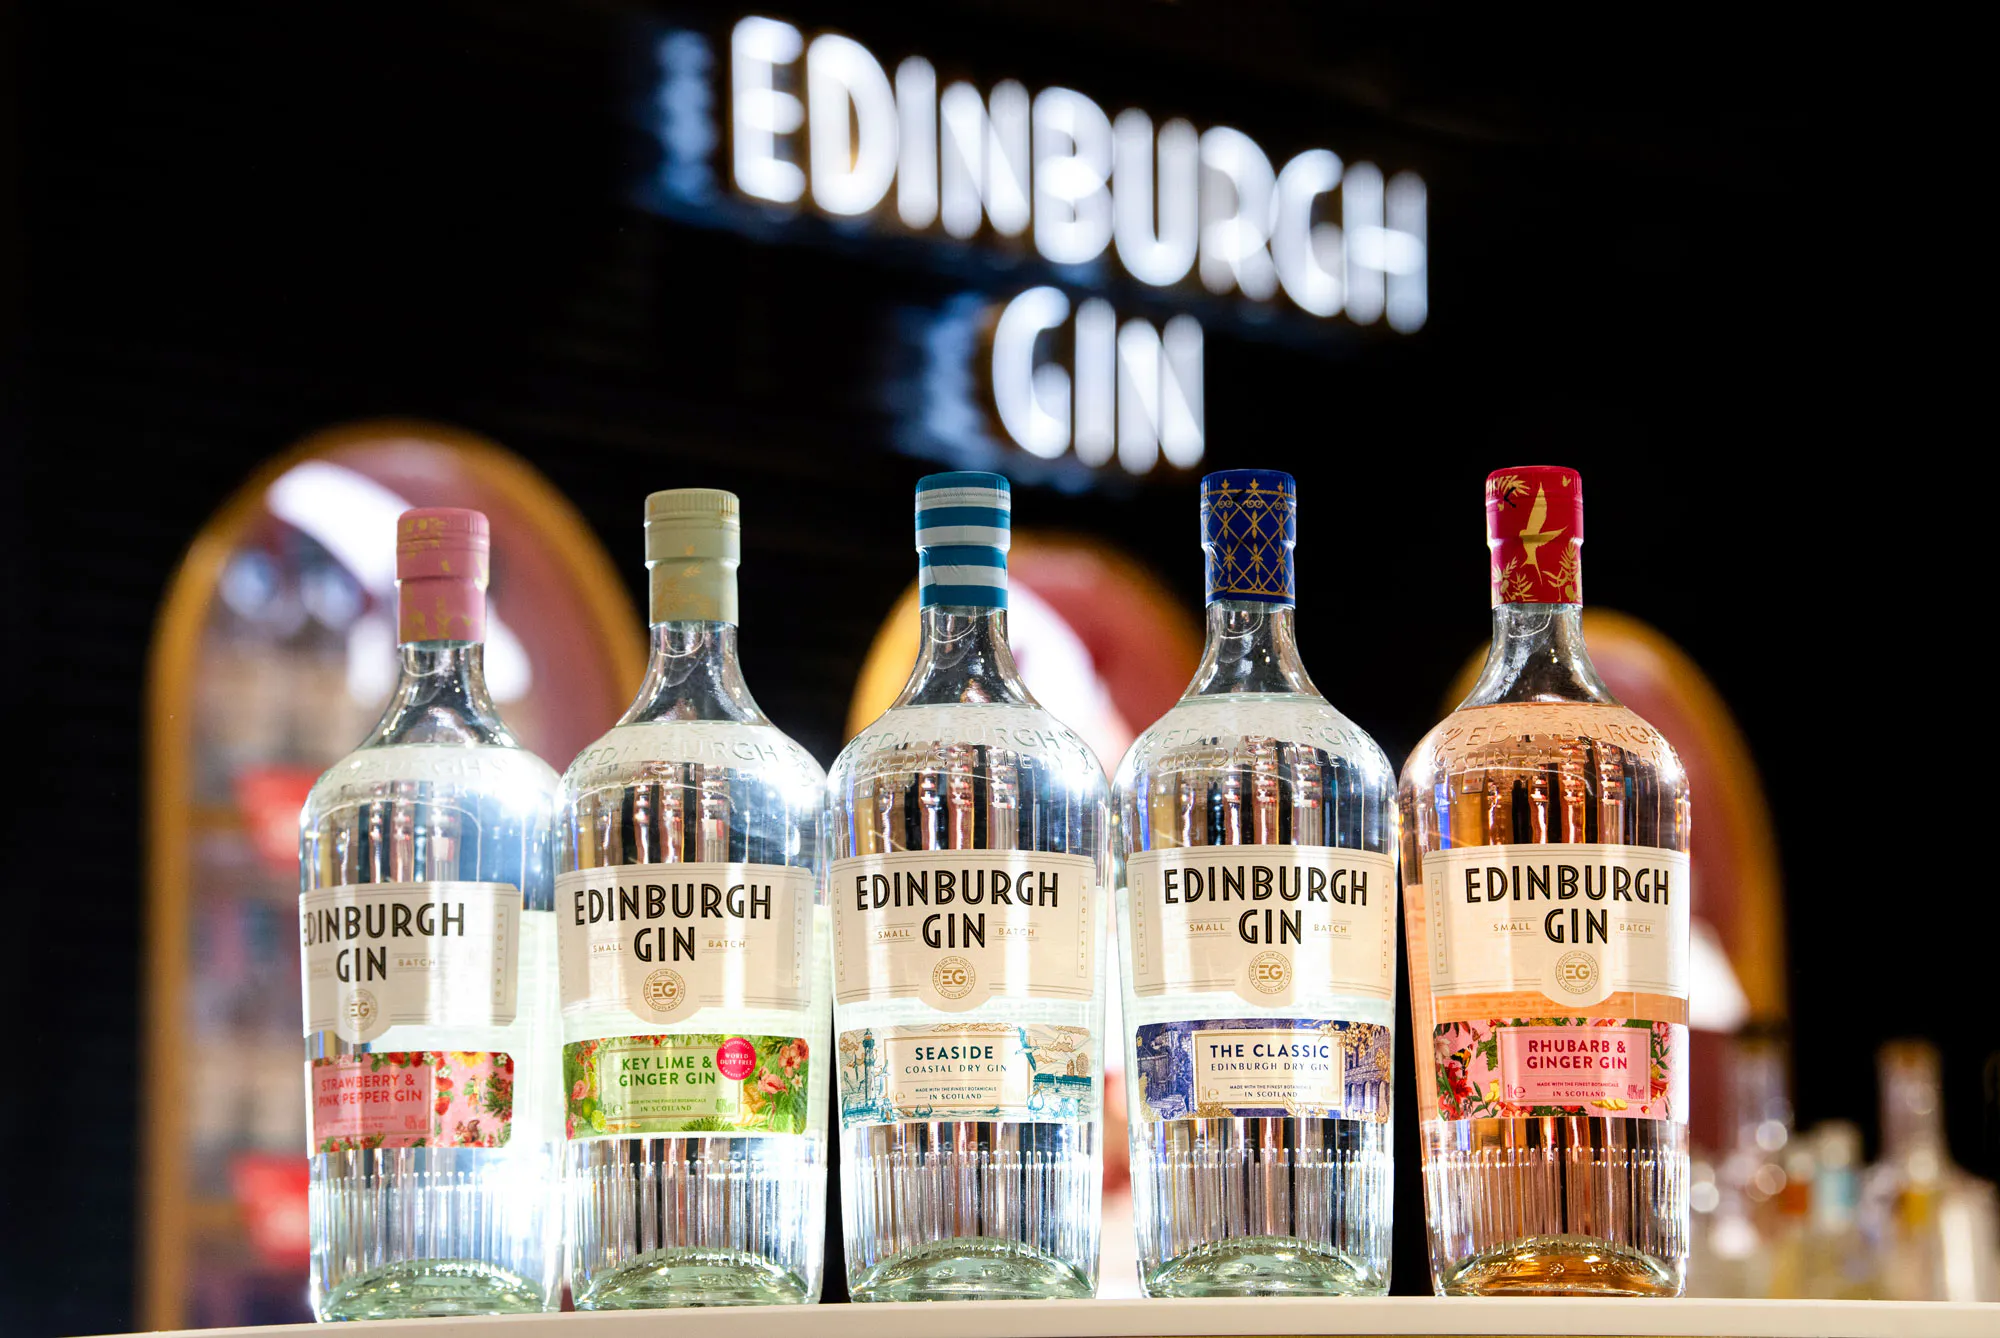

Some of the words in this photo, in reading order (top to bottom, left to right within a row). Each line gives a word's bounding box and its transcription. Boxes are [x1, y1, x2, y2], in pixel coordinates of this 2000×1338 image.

[731, 15, 1428, 334] EDINBURGH
[992, 285, 1205, 475] GIN
[856, 869, 1059, 911] EDINBURGH
[1164, 865, 1367, 906] EDINBURGH
[1465, 864, 1669, 905] EDINBURGH
[574, 883, 771, 926] EDINBURGH
[878, 930, 911, 939] SMALL
[998, 928, 1035, 936] BATCH
[922, 913, 985, 948] GIN
[1189, 922, 1225, 932] SMALL
[1314, 923, 1347, 933] BATCH
[1239, 909, 1302, 944] GIN
[1493, 923, 1531, 932] SMALL
[1619, 923, 1651, 933] BATCH
[1544, 908, 1608, 944] GIN
[592, 943, 623, 953] SMALL
[708, 939, 746, 948] BATCH
[633, 927, 695, 962] GIN
[336, 946, 386, 983] GIN
[398, 958, 436, 967] BATCH
[942, 970, 967, 985] EG
[1259, 964, 1283, 980] EG
[1566, 964, 1590, 980] EG
[653, 982, 677, 997] EG
[351, 1002, 369, 1017] EG
[915, 1046, 993, 1060] SEASIDE
[1210, 1045, 1244, 1058] THE
[1253, 1044, 1329, 1058] CLASSIC
[1528, 1040, 1610, 1052] RHUBARB
[1616, 1040, 1626, 1053] &
[622, 1056, 650, 1070] KEY
[656, 1056, 695, 1069] LIME
[702, 1055, 712, 1068] &
[905, 1065, 952, 1074] COASTAL
[987, 1064, 1007, 1072] GIN
[1211, 1063, 1277, 1071] EDINBURGH
[1284, 1063, 1305, 1071] DRY
[1526, 1056, 1593, 1069] GINGER
[1600, 1057, 1628, 1069] GIN
[321, 1074, 400, 1091] STRAWBERRY
[404, 1073, 415, 1086] &
[619, 1073, 679, 1087] GINGER
[685, 1072, 716, 1085] GIN
[318, 1094, 340, 1107] PINK
[342, 1090, 390, 1105] PEPPER
[394, 1089, 422, 1102] GIN
